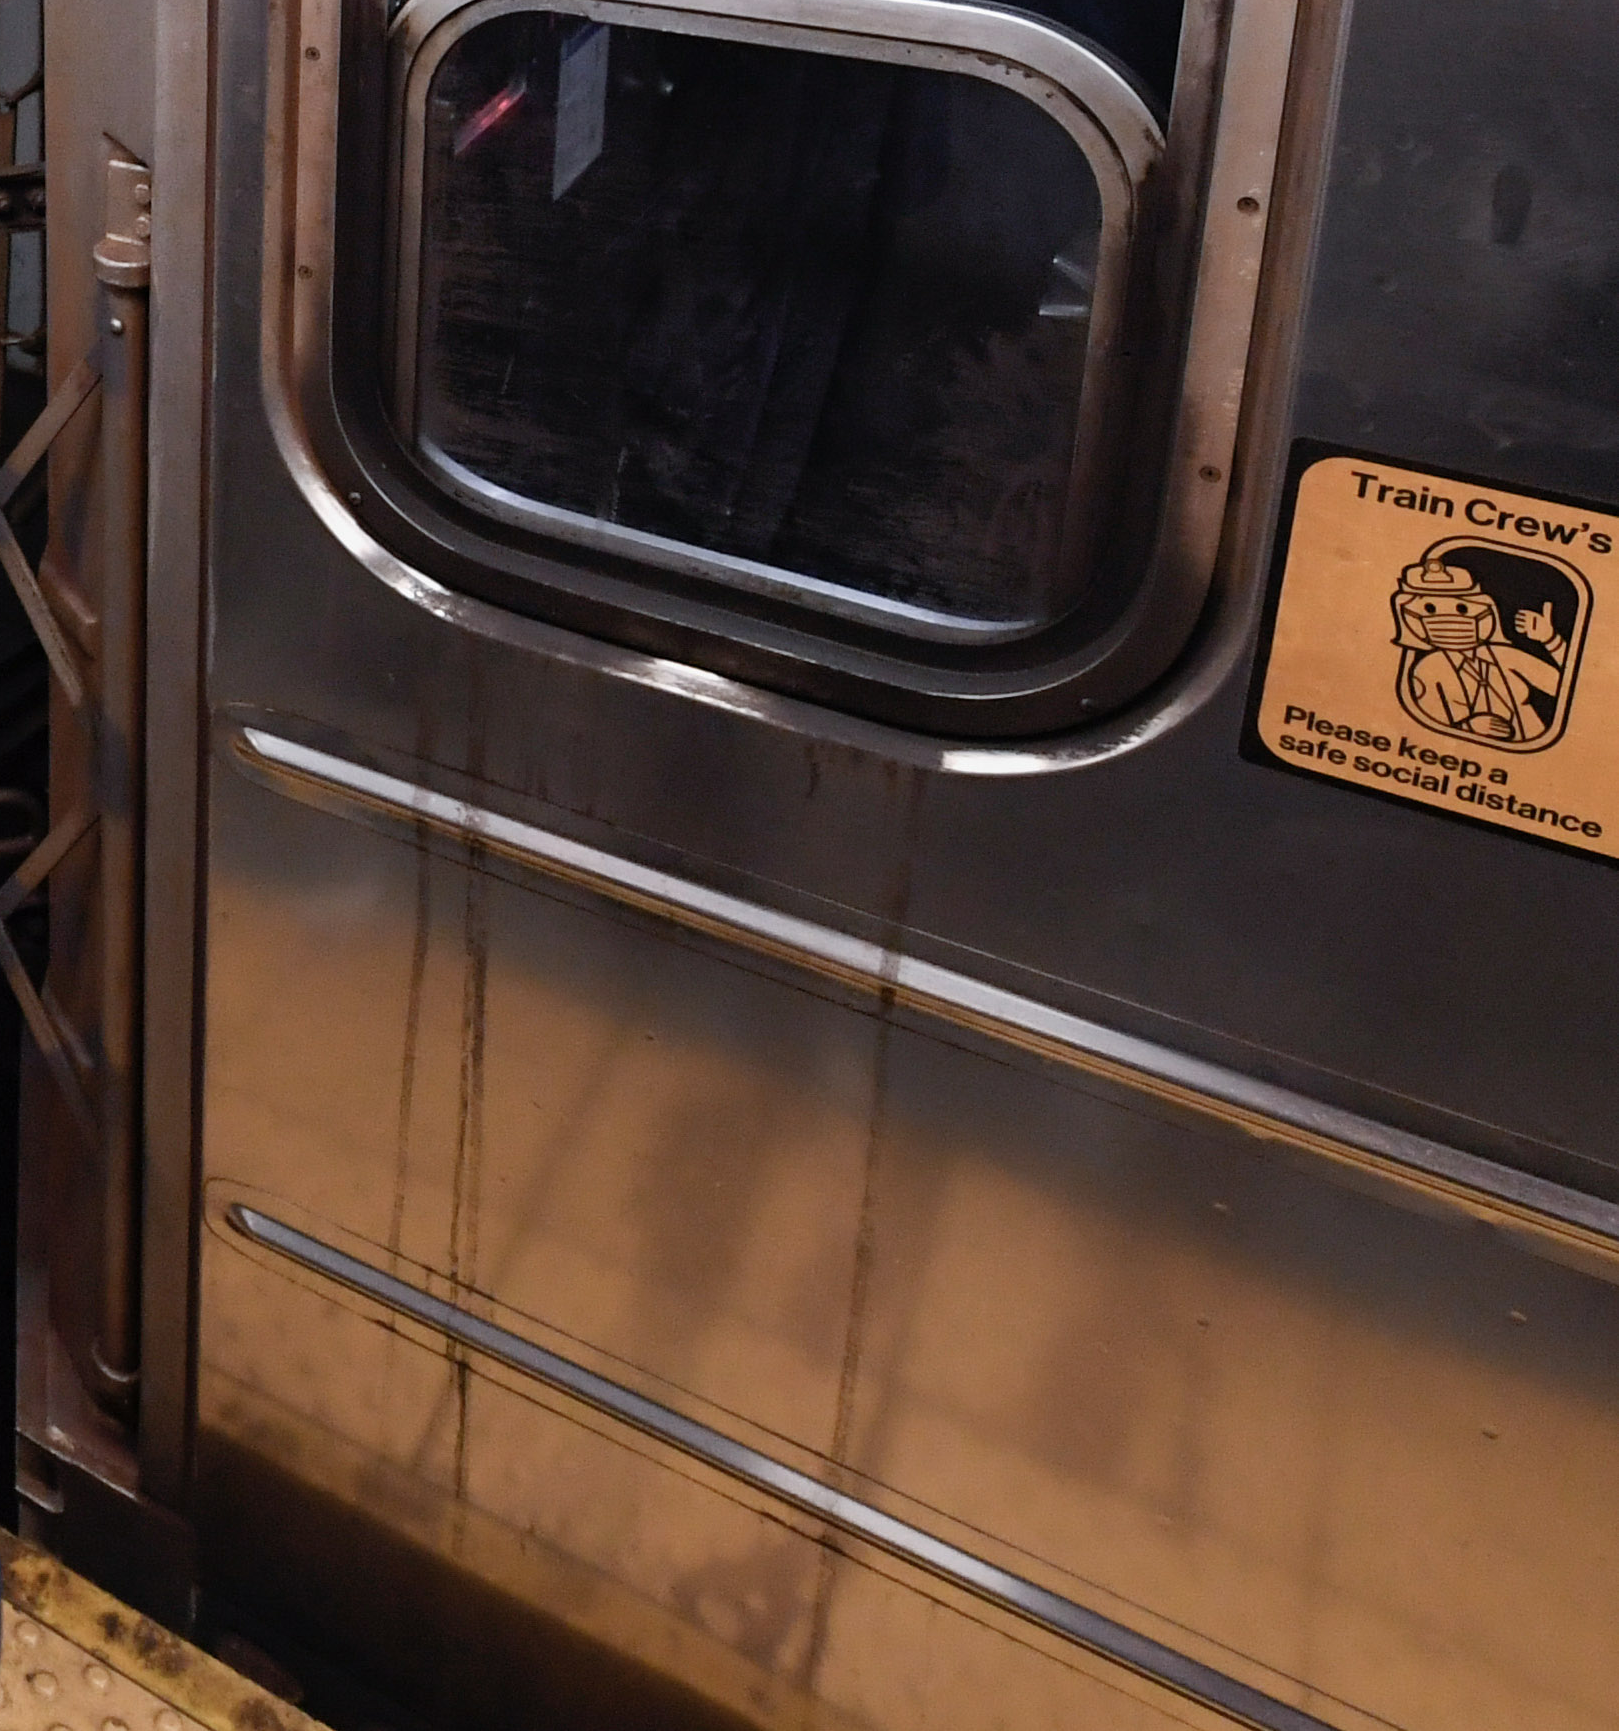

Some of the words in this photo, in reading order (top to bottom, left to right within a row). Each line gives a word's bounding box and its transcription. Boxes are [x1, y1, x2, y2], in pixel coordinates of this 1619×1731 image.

[1351, 470, 1455, 519] Train
[1464, 498, 1613, 555] Crew's
[1278, 734, 1348, 765] safe
[1352, 753, 1449, 796] social
[1455, 783, 1604, 839] distance
[1283, 704, 1392, 752] Please
[1398, 736, 1482, 779] keep
[1488, 767, 1508, 785] a
